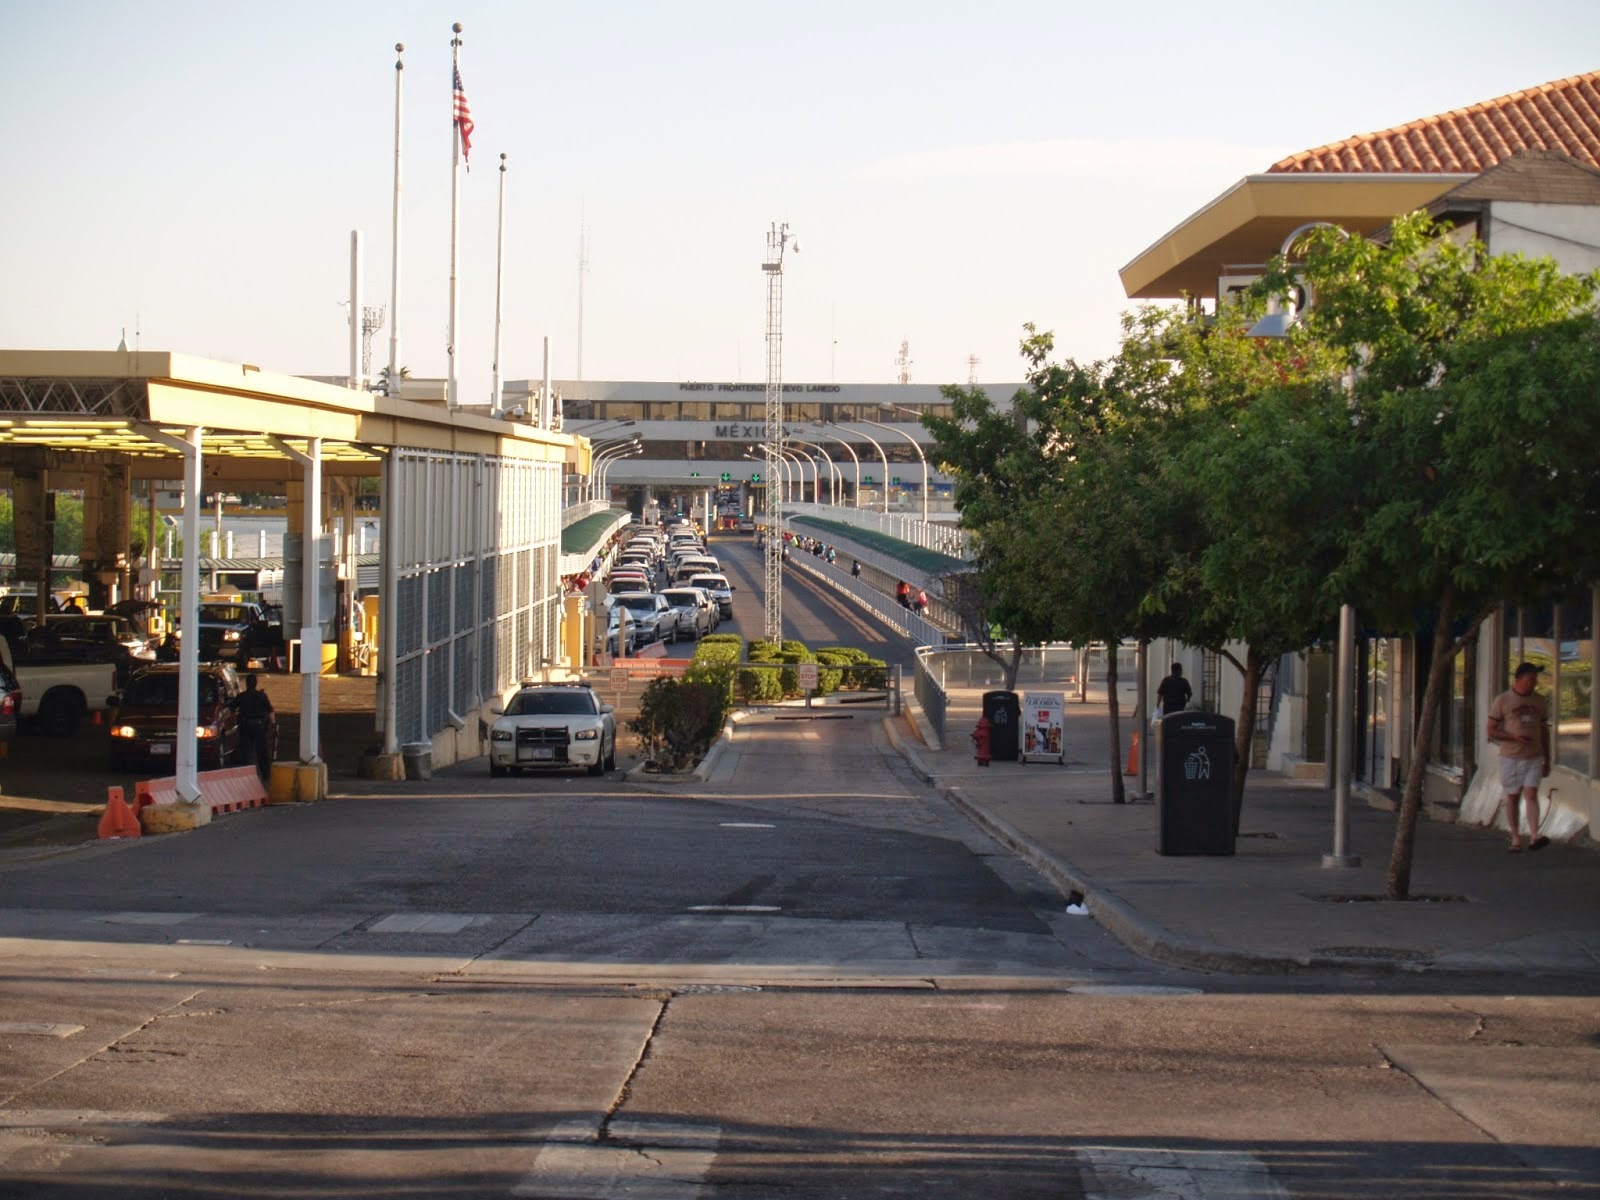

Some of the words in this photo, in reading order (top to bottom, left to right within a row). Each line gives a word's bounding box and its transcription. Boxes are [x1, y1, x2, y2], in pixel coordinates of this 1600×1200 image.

[680, 383, 714, 391] PUERTO
[718, 384, 770, 392] FRONTERIZ
[806, 385, 840, 393] LAREDO
